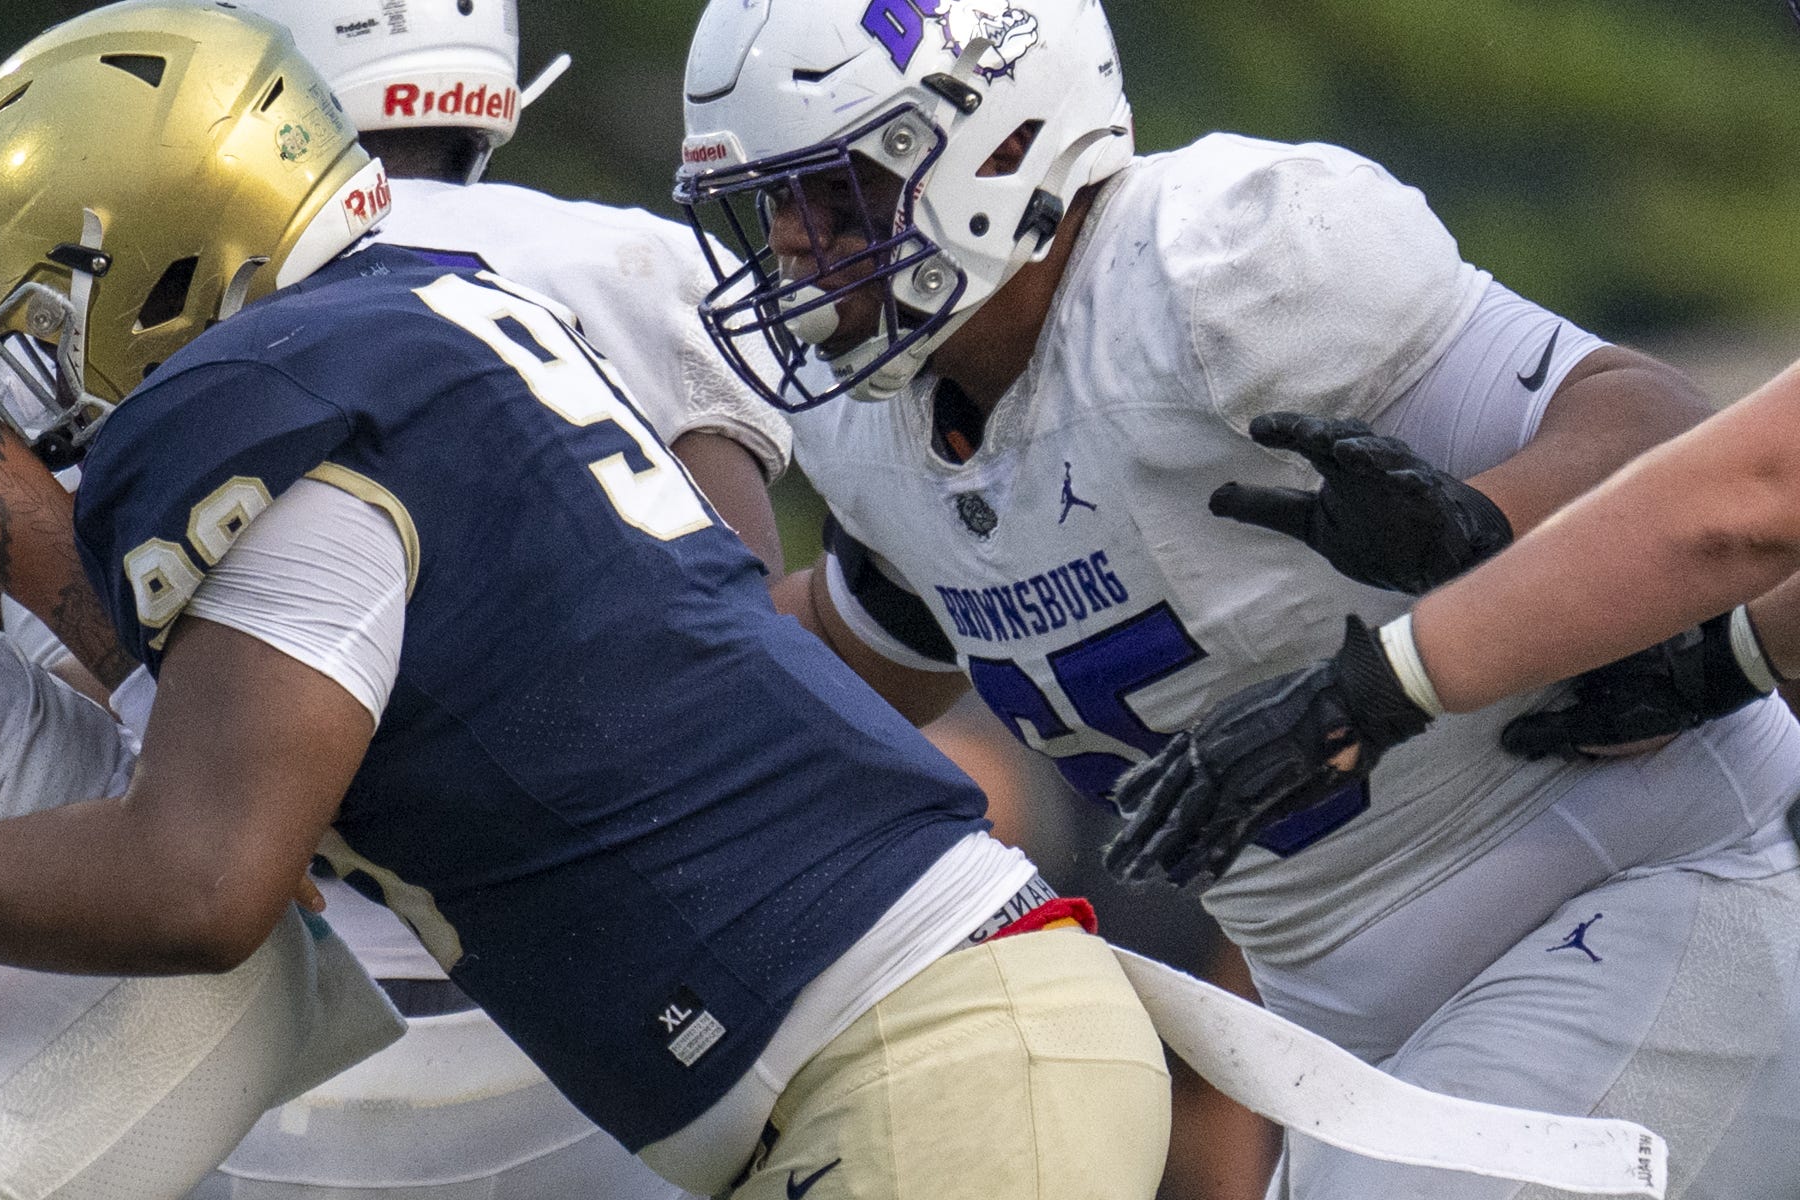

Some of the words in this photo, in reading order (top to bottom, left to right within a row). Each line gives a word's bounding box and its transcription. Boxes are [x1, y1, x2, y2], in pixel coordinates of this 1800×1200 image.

[383, 82, 515, 121] Riddell
[934, 550, 1129, 642] BROWNSBURG
[658, 1004, 692, 1033] XL
